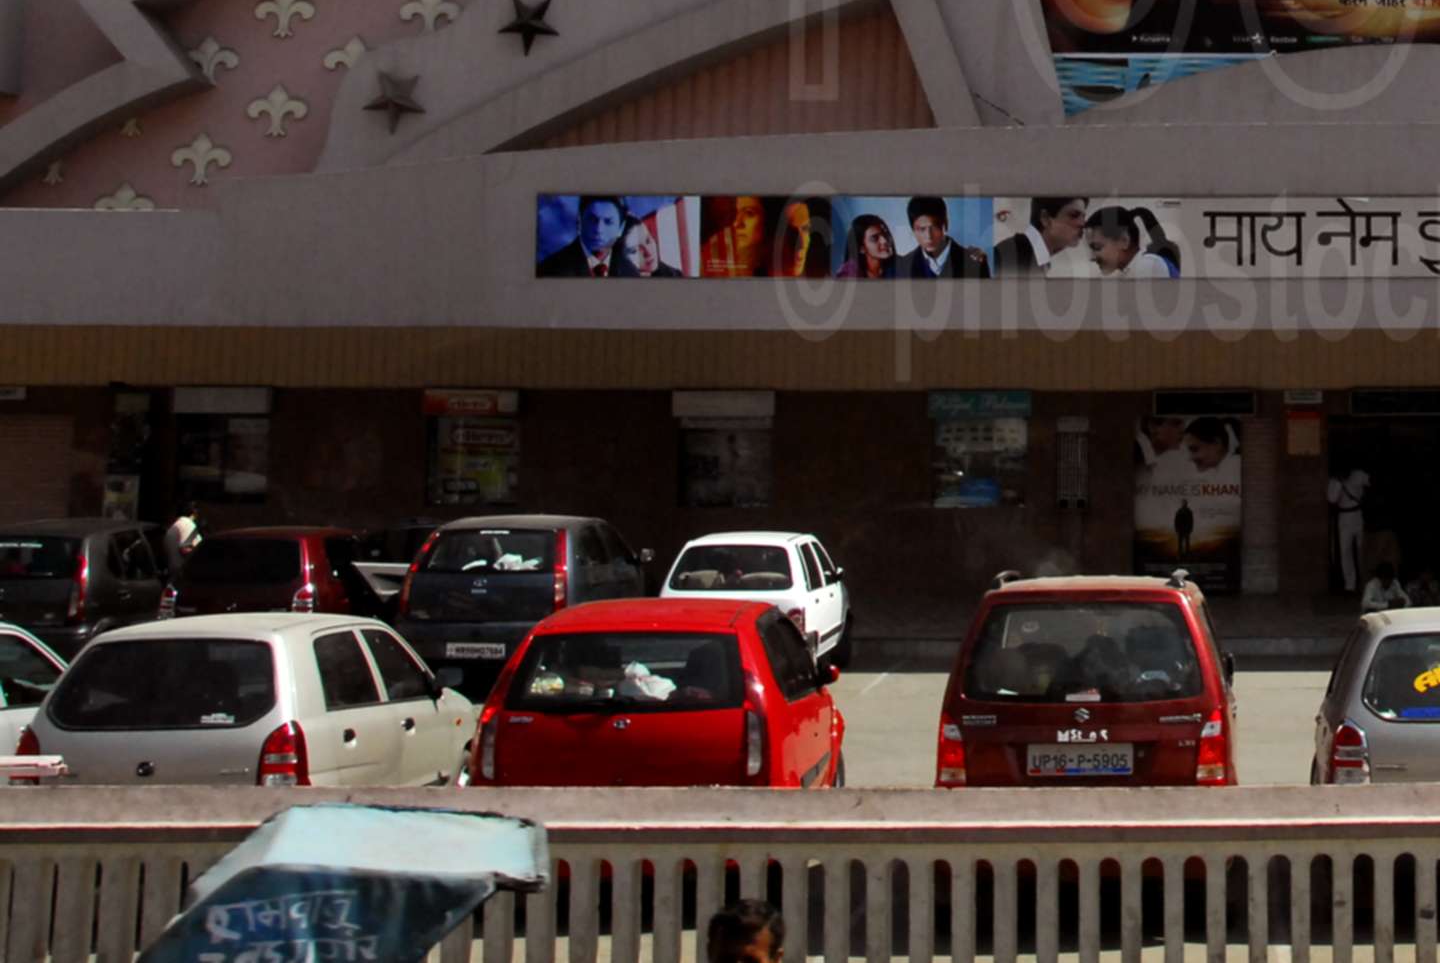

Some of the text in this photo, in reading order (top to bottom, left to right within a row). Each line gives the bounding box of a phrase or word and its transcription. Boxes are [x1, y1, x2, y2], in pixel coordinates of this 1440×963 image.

[1203, 210, 1306, 266] माय
[1316, 197, 1401, 266] नेम
[1202, 483, 1239, 495] KHAN
